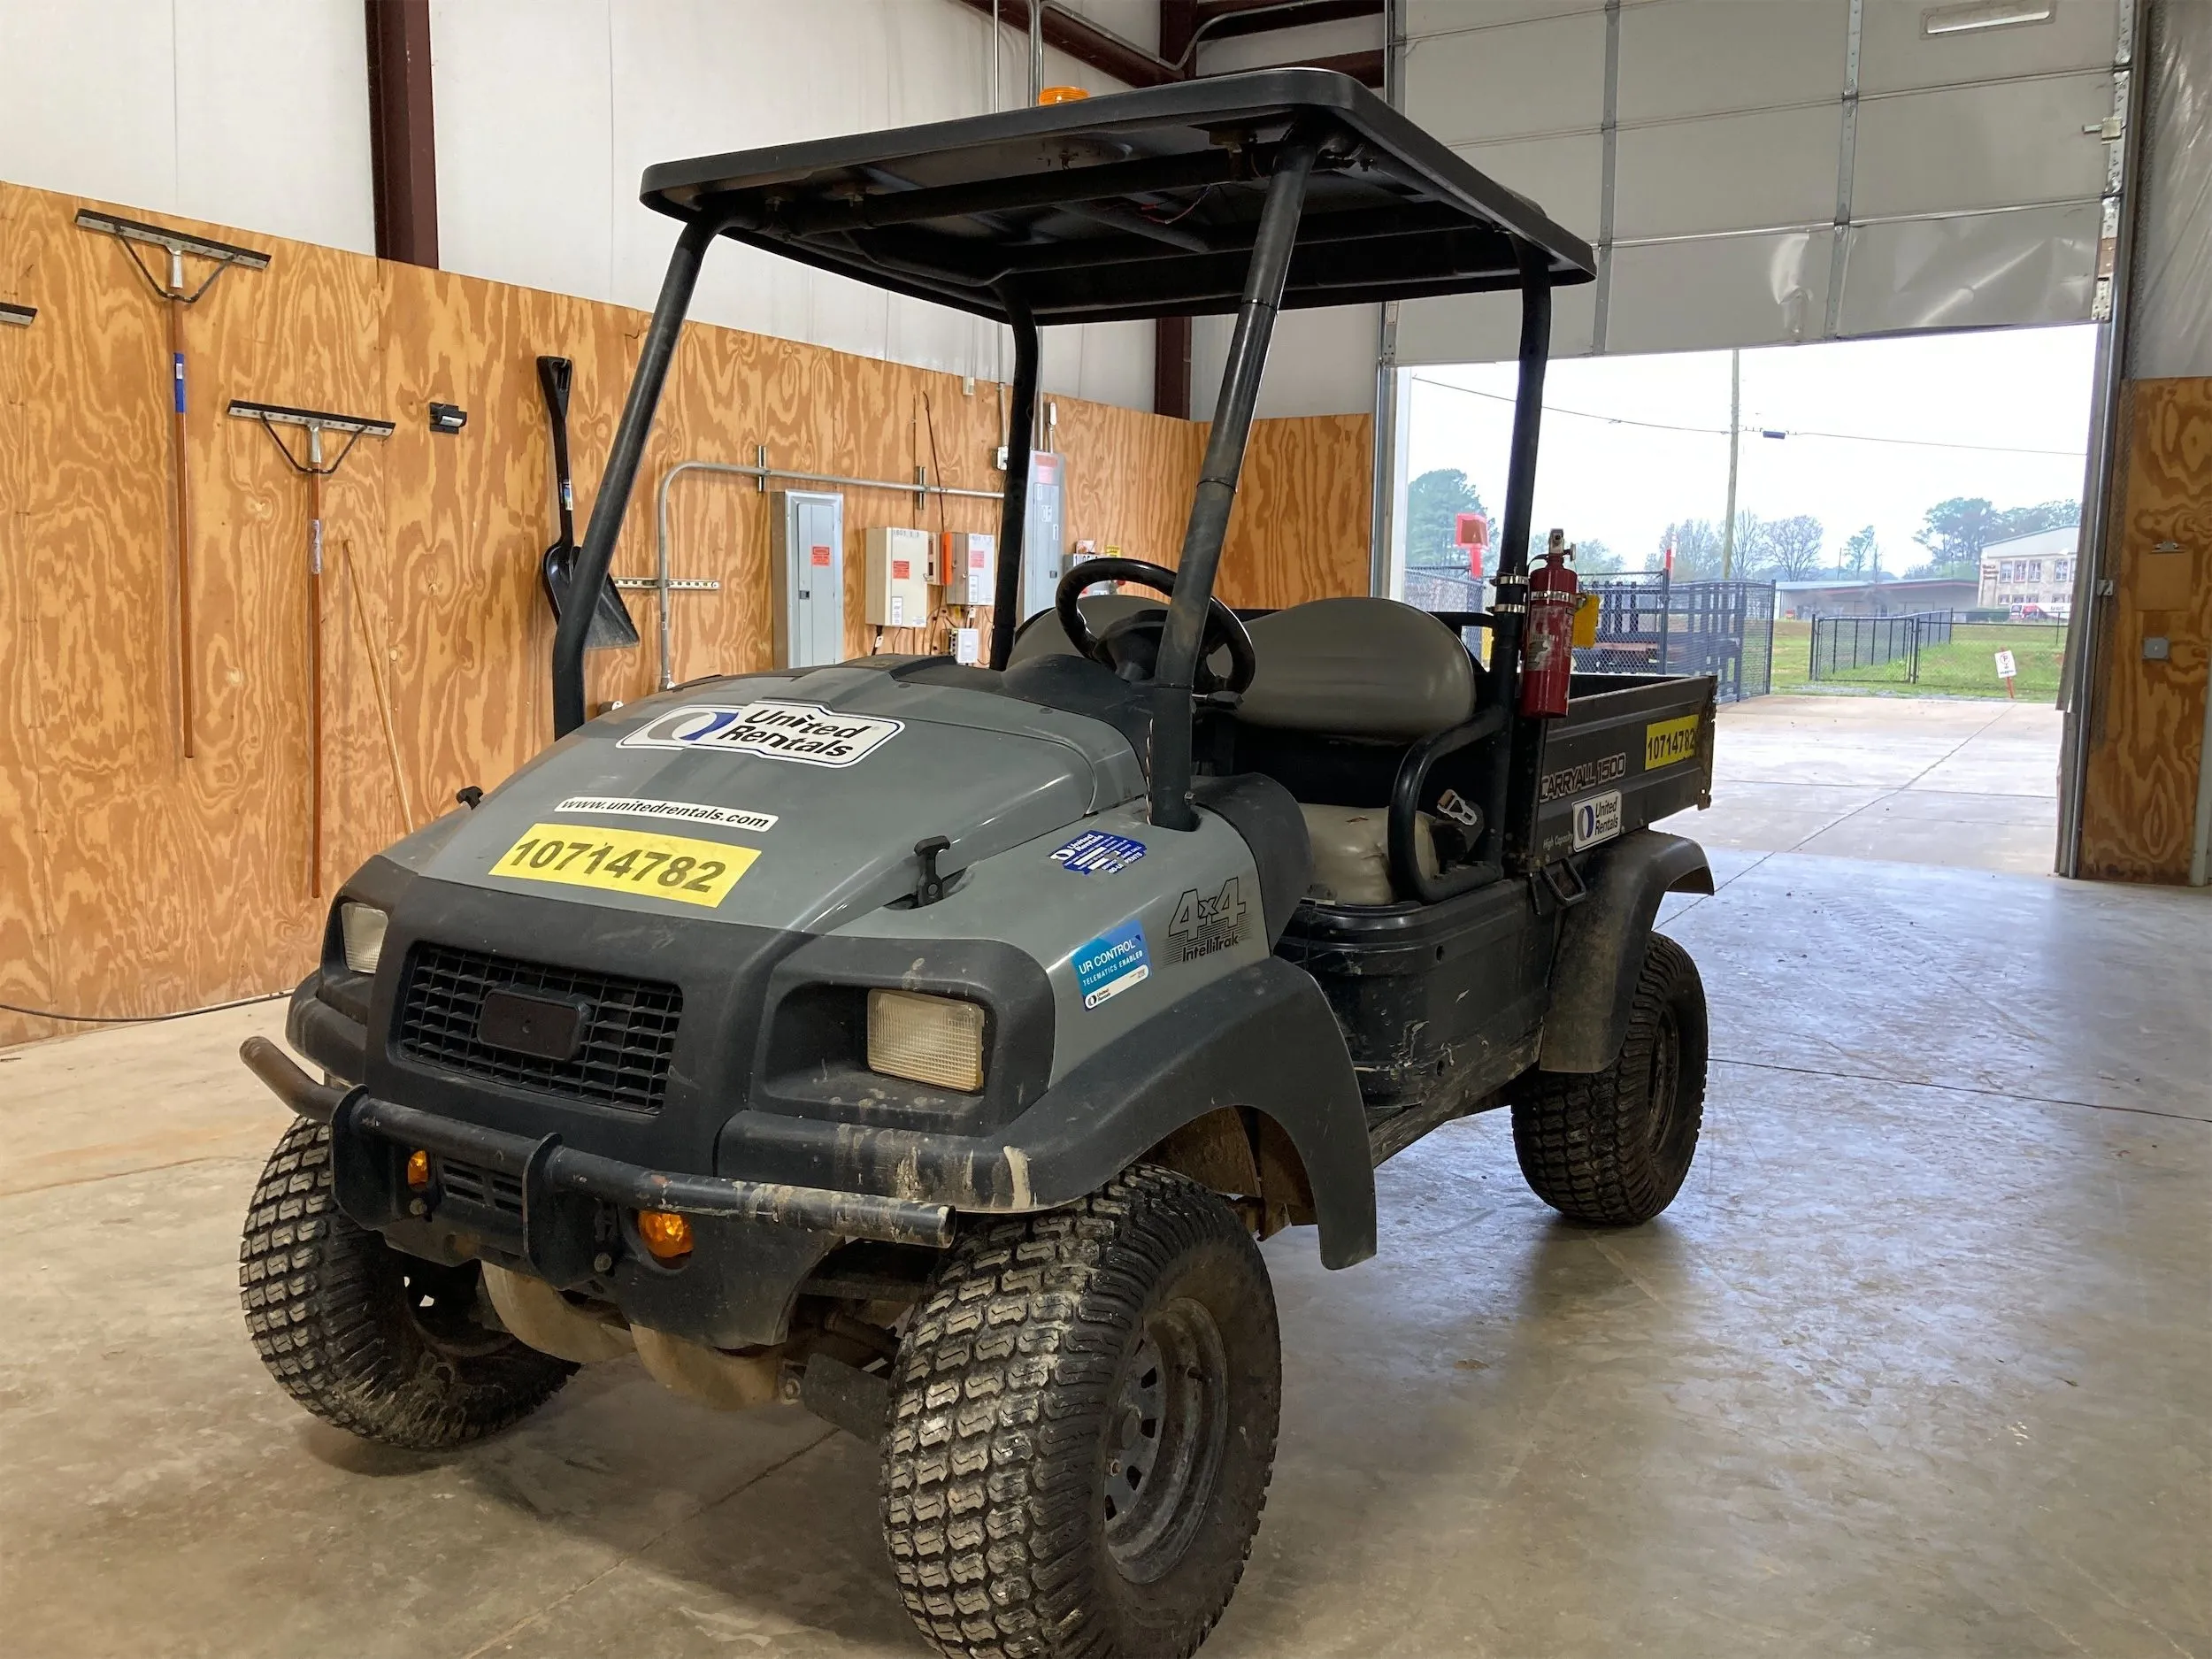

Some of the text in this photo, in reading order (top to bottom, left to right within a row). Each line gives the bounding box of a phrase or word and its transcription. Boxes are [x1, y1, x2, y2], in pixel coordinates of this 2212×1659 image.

[744, 710, 872, 739] United
[717, 725, 853, 757] Rentals
[1647, 728, 1695, 761] 10714782
[1540, 753, 1626, 803] CARRYALL 1500
[561, 798, 769, 828] www.unitedrentals.com
[1594, 796, 1617, 818] United
[1067, 833, 1094, 849] United
[1594, 817, 1618, 836] Rentals
[509, 838, 726, 894] 10714782
[1169, 876, 1247, 942] 4x4
[1079, 939, 1136, 975] UR CONTROL
[1182, 933, 1239, 963] IntelliTrak
[1082, 964, 1118, 987] TELEMATICS
[1118, 949, 1143, 968] ENABLED
